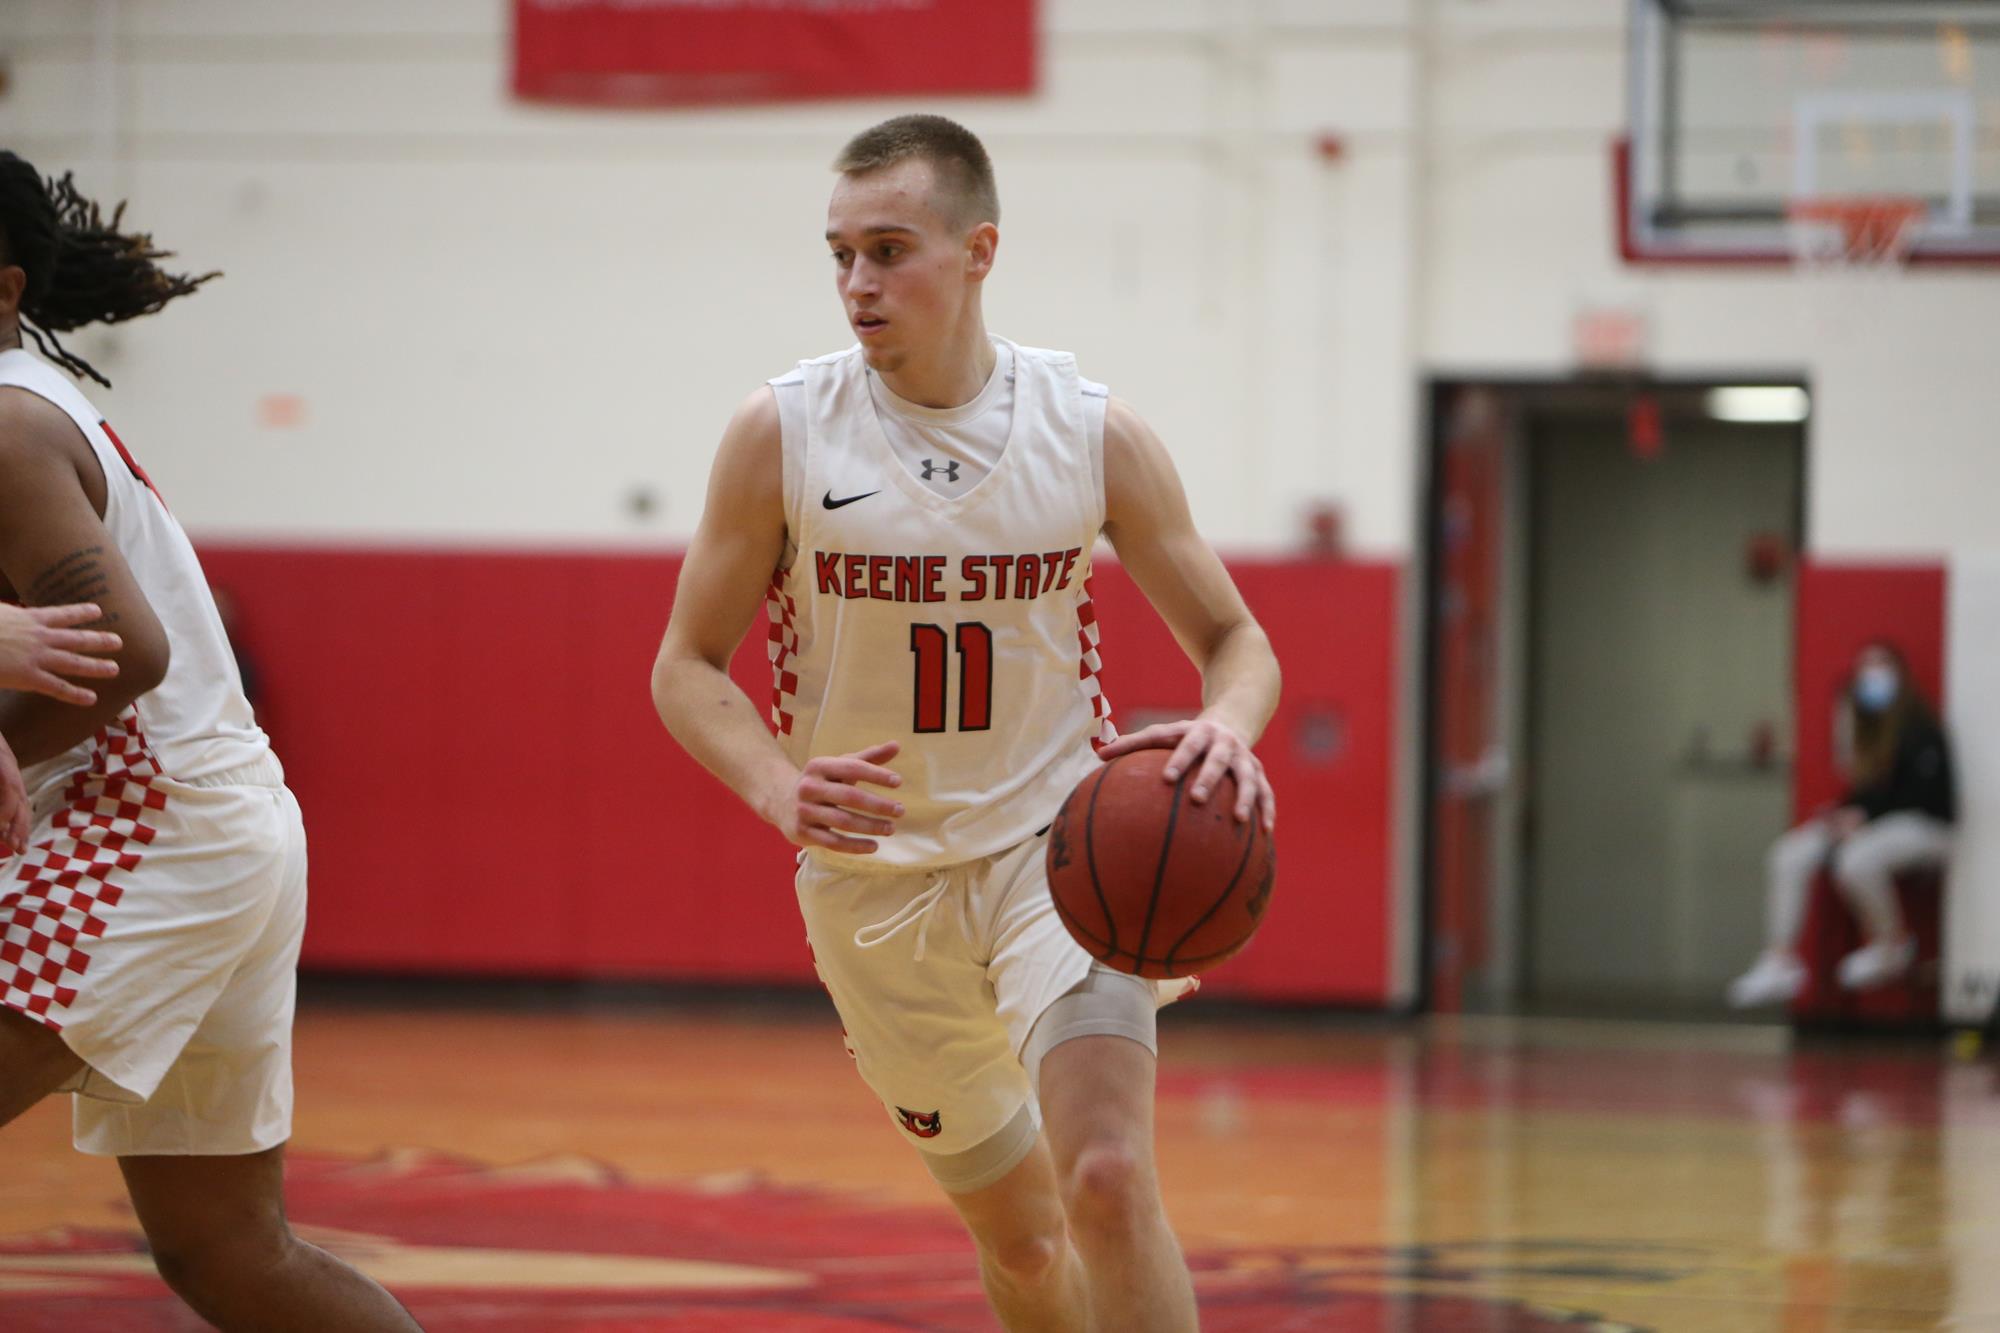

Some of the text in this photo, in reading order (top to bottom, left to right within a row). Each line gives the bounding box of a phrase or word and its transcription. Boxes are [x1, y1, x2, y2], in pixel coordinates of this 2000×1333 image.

[815, 547, 1082, 603] KEENE STATE
[910, 621, 993, 734] 11
